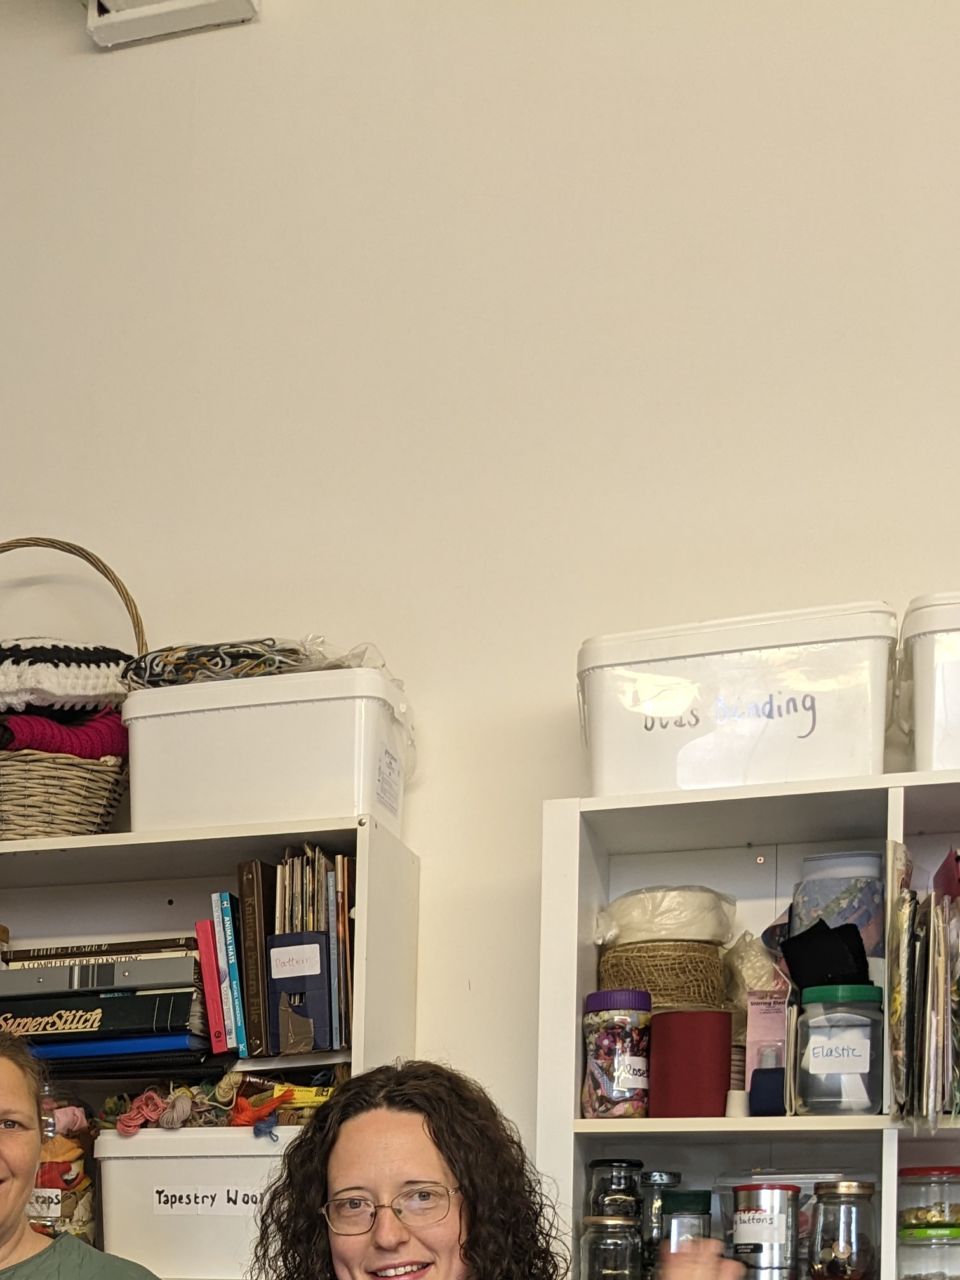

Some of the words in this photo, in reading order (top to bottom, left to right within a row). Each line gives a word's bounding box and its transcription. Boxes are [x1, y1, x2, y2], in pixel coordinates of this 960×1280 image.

[223, 916, 234, 945] ANIMAL
[28, 959, 67, 970] COMPLETE
[69, 957, 91, 967] GUIDE
[93, 956, 105, 965] TO
[105, 954, 142, 964] KNITTING
[227, 945, 236, 964] HATS
[812, 1045, 862, 1059] Elastic
[155, 1188, 217, 1208] Tapestry
